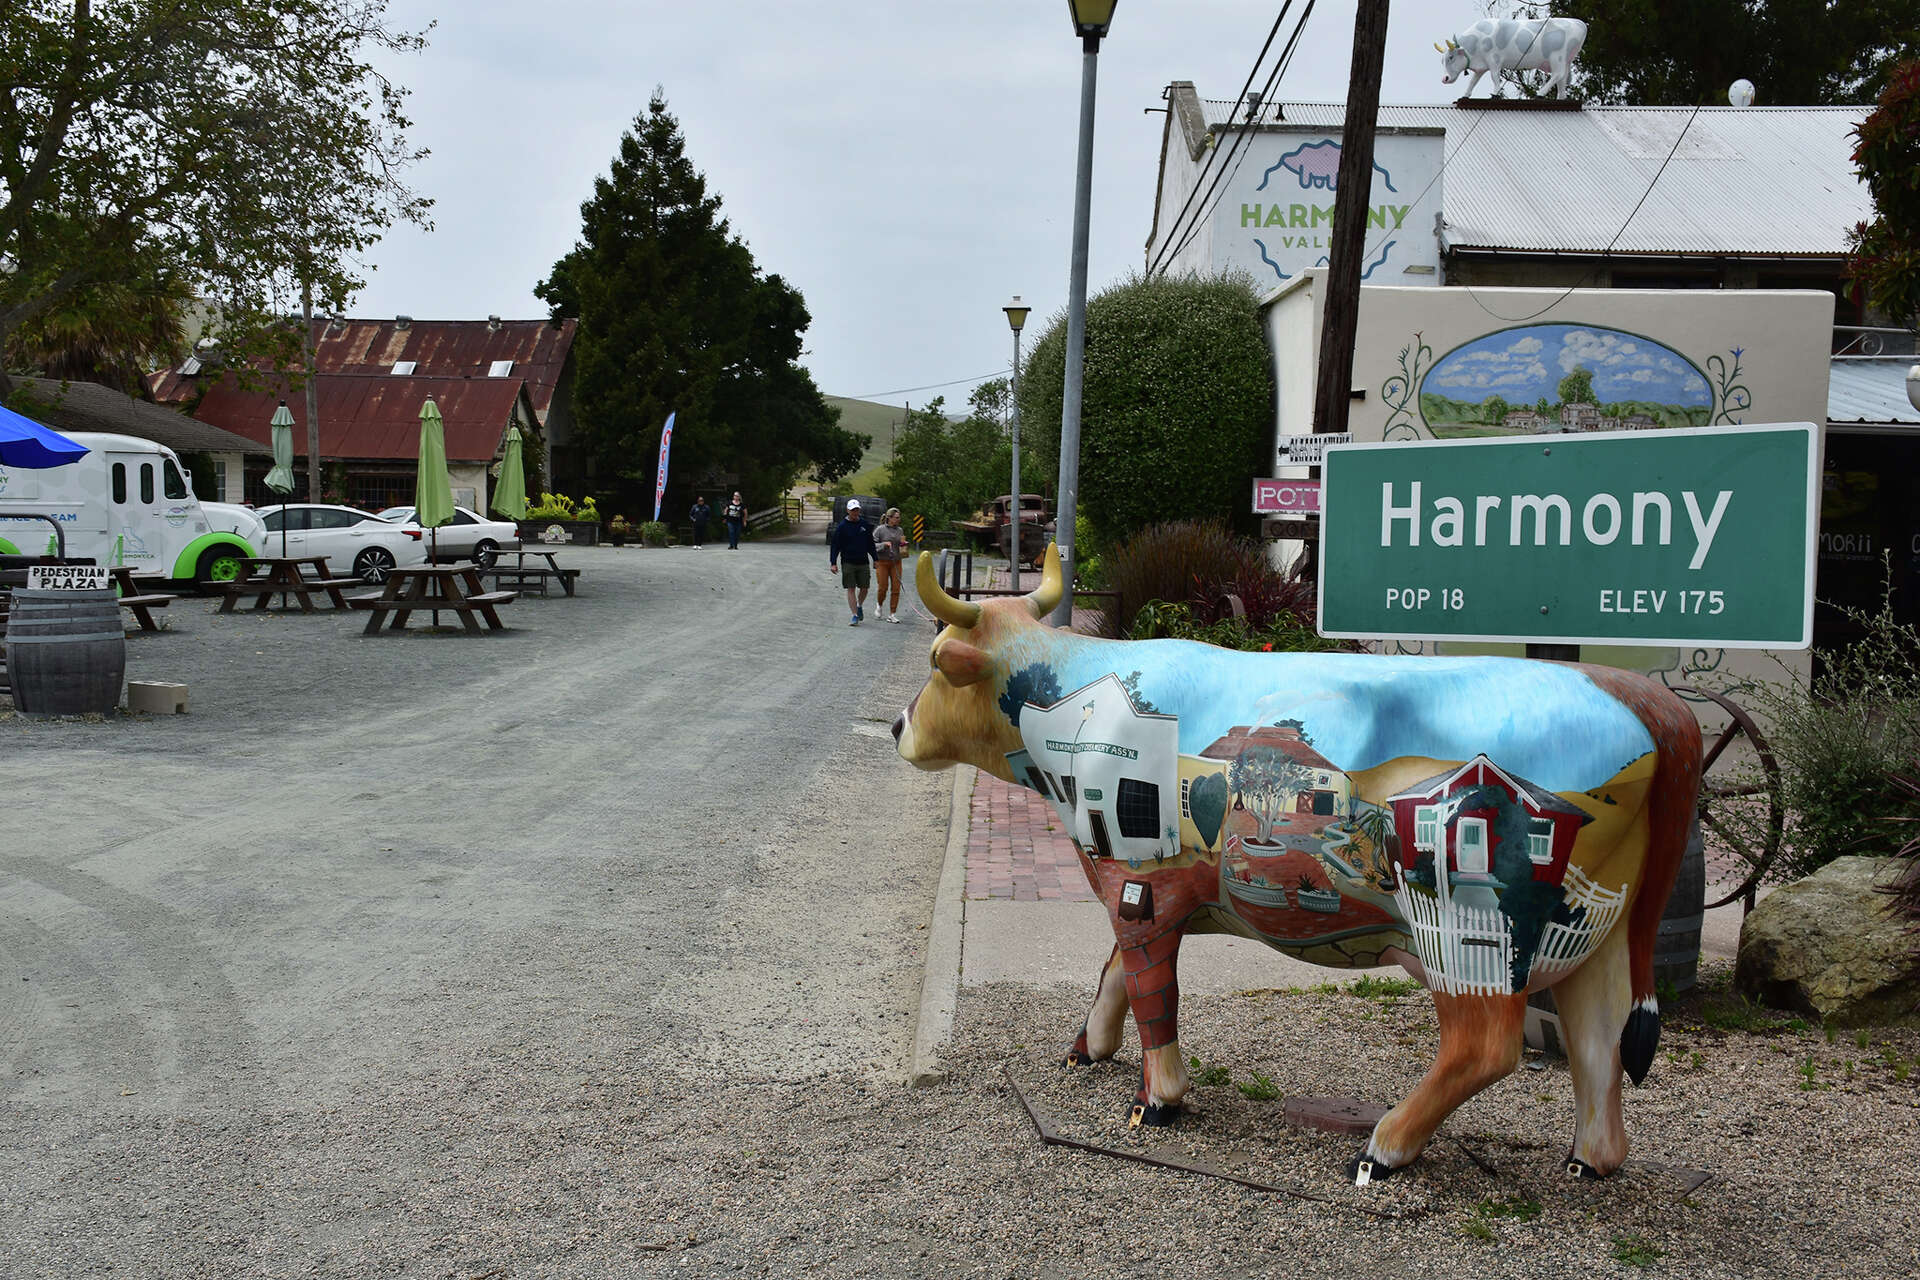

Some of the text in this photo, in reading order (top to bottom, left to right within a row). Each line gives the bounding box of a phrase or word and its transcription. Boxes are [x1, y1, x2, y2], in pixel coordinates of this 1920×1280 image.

[1241, 203, 1410, 229] HARMNY
[1380, 480, 1734, 570] Harmony
[33, 567, 105, 578] PEDESTRIAN
[41, 578, 97, 589] PLAZA
[1386, 588, 1465, 611] POP 18
[1599, 590, 1725, 615] ELEV 175
